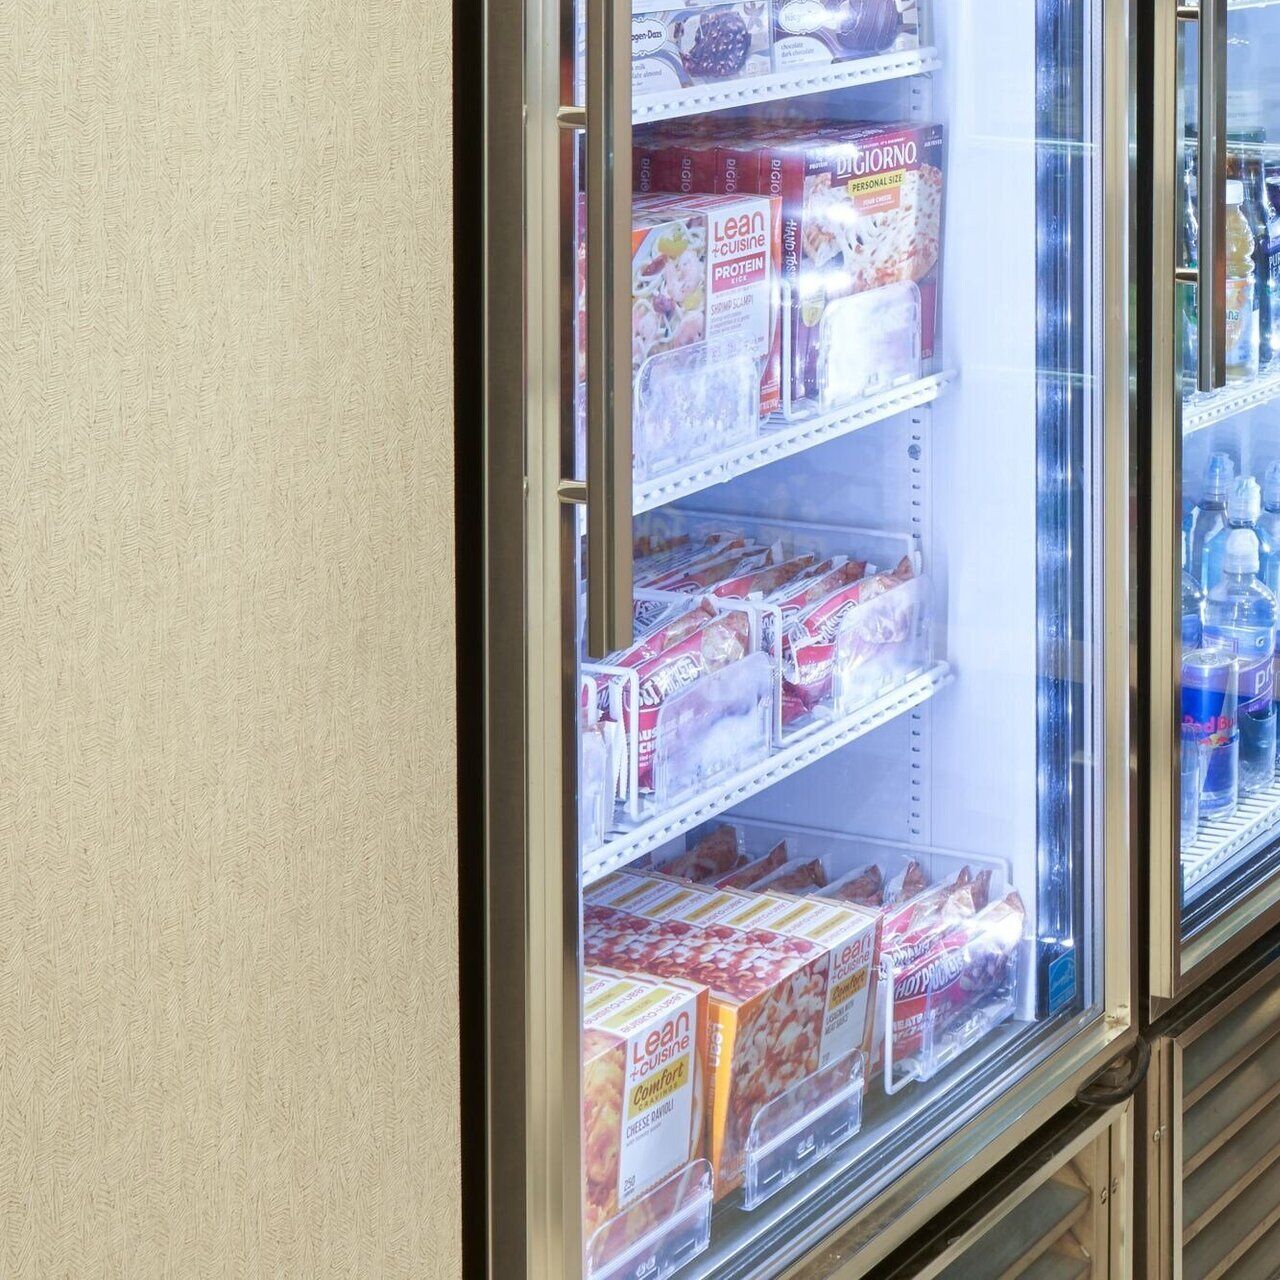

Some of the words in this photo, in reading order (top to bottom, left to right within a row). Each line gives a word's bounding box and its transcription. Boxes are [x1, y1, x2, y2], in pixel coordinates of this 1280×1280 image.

[836, 141, 918, 177] DIGIORNO
[852, 178, 888, 193] PERSONAL
[888, 173, 903, 186] SIZE
[714, 210, 765, 242] Lean
[715, 256, 764, 281] PROTEIN
[730, 276, 748, 284] KICK
[833, 932, 871, 969] Lean
[895, 975, 921, 999] HOT
[633, 1010, 690, 1065] Lean
[633, 1061, 684, 1106] Comfort
[638, 1080, 679, 1112] CRAVINGS
[626, 1113, 651, 1140] CHEESE
[651, 1098, 675, 1123] RAVIOLI
[624, 1175, 636, 1192] 250
